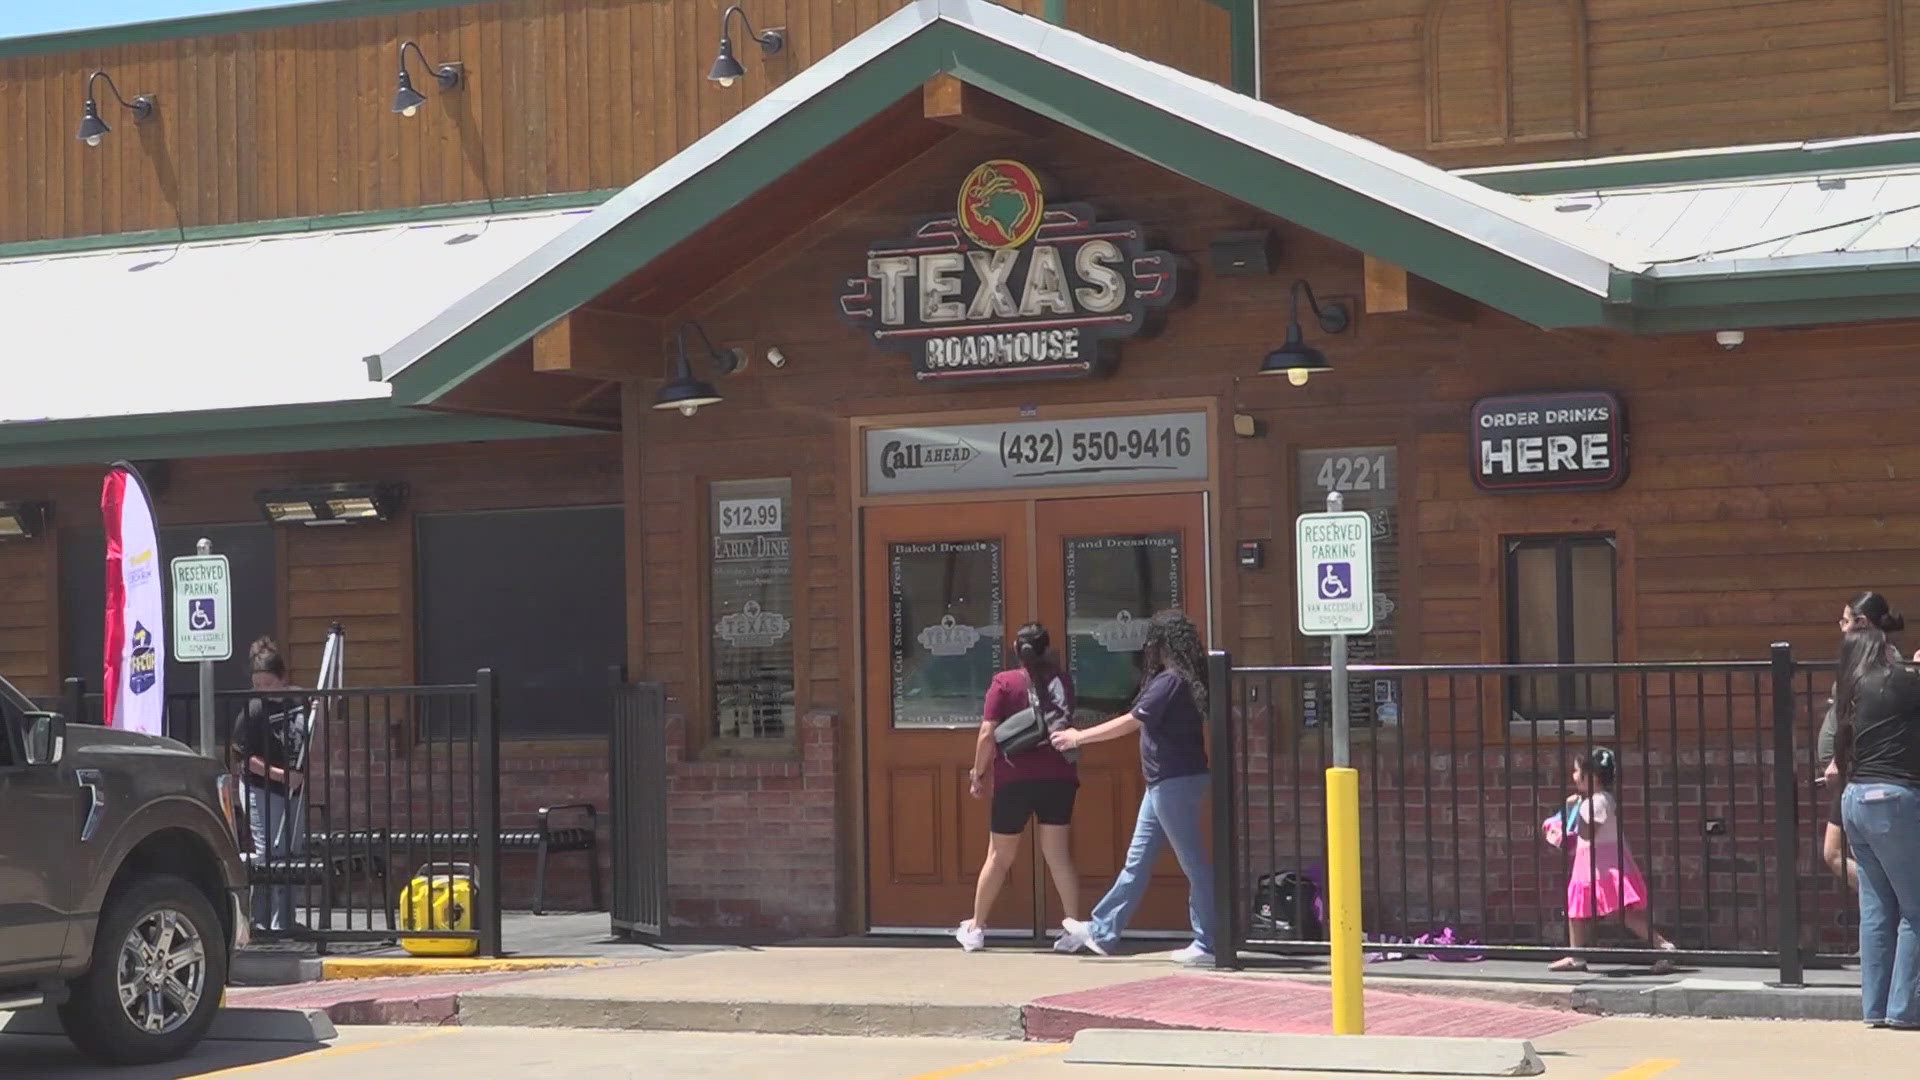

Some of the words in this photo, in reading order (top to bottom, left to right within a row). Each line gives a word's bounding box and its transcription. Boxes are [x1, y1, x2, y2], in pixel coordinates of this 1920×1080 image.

[867, 240, 1126, 325] TEXAS
[926, 330, 1079, 369] ROADHOUSE
[1480, 411, 1539, 428] ORDER
[1545, 407, 1609, 424] DRINKS
[880, 440, 923, 479] Call
[924, 447, 970, 463] AHEAD
[1000, 428, 1063, 468] (432)
[1072, 427, 1191, 462] 550-9416
[1481, 433, 1610, 475] HERE
[1316, 455, 1386, 492] 4221
[723, 504, 778, 527] $12.99
[1077, 539, 1103, 548] and
[1106, 538, 1174, 548] Dressings
[1305, 524, 1362, 542] RESERVED
[895, 543, 936, 553] Baked
[1312, 544, 1356, 559] PARKING
[179, 565, 224, 581] RESERVED
[990, 543, 999, 584] Award
[892, 556, 901, 597] Fresh
[184, 582, 219, 595] PARKING
